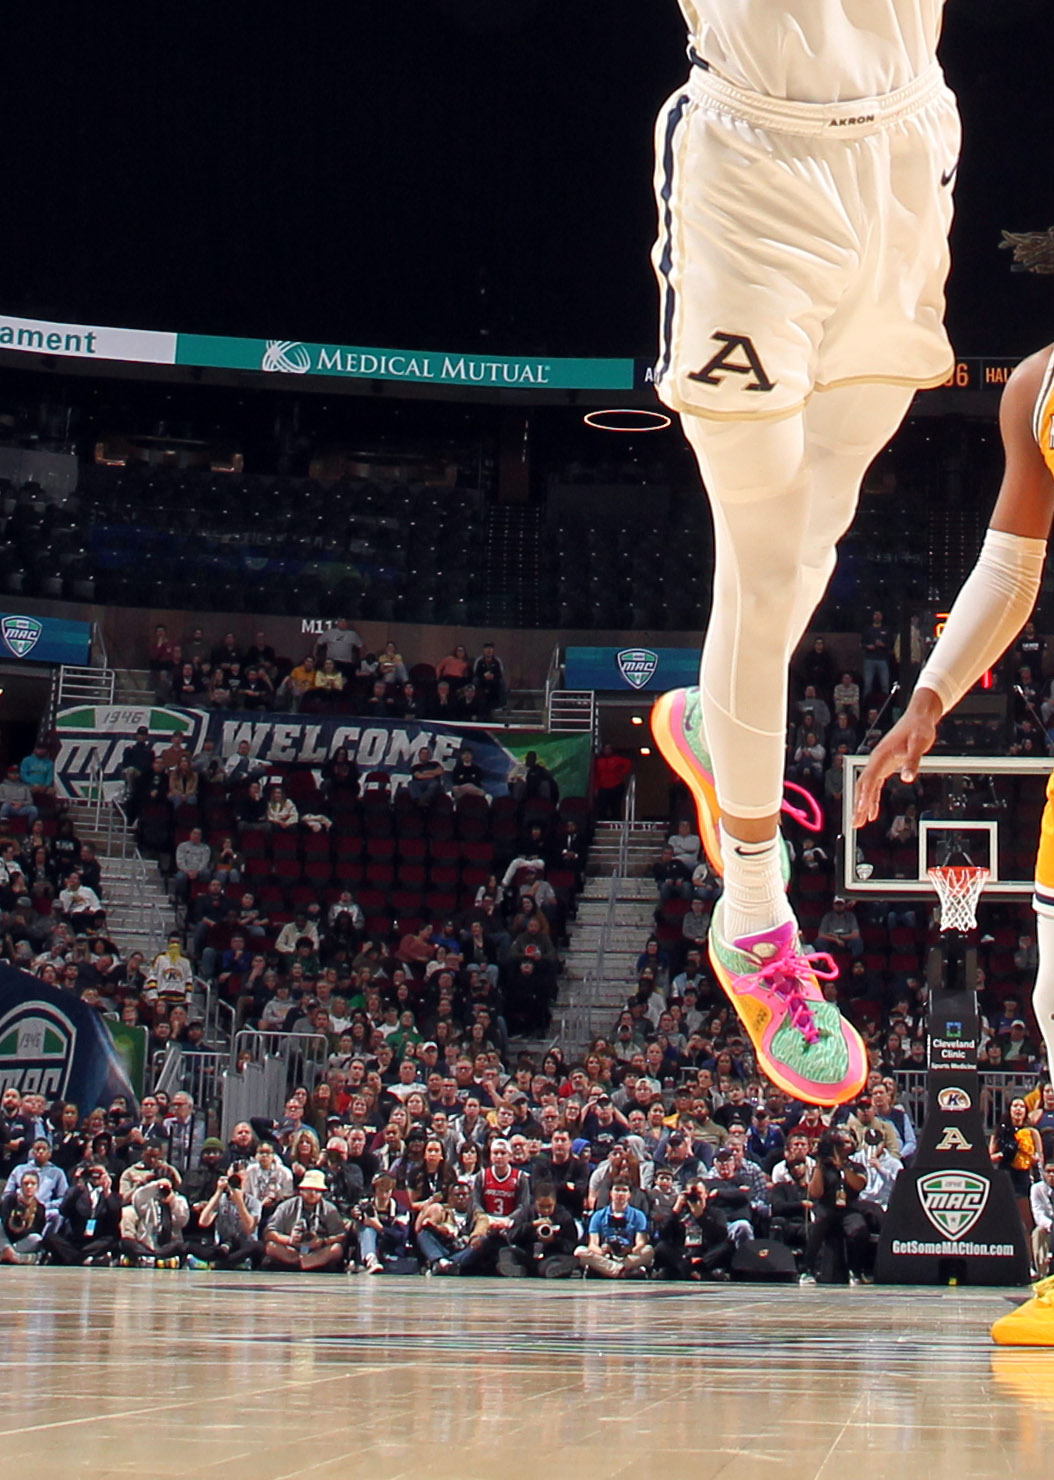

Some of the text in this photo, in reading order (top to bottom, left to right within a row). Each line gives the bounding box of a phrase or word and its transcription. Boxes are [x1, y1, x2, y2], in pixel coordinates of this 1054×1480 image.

[828, 114, 875, 128] AKRON
[0, 326, 97, 353] ament
[316, 349, 549, 383] MEDICAL MUTUAL
[686, 331, 778, 392] A
[5, 628, 38, 640] MAC
[622, 661, 654, 671] MAC
[102, 710, 145, 725] 1946
[222, 720, 463, 771] WELCOME
[932, 1038, 975, 1049] Cleveland
[941, 1049, 966, 1059] Clinic
[935, 1126, 973, 1150] A
[494, 1198, 504, 1215] 3
[925, 1193, 982, 1209] MAC
[892, 1240, 1014, 1256] GetSomeMACtion.com
